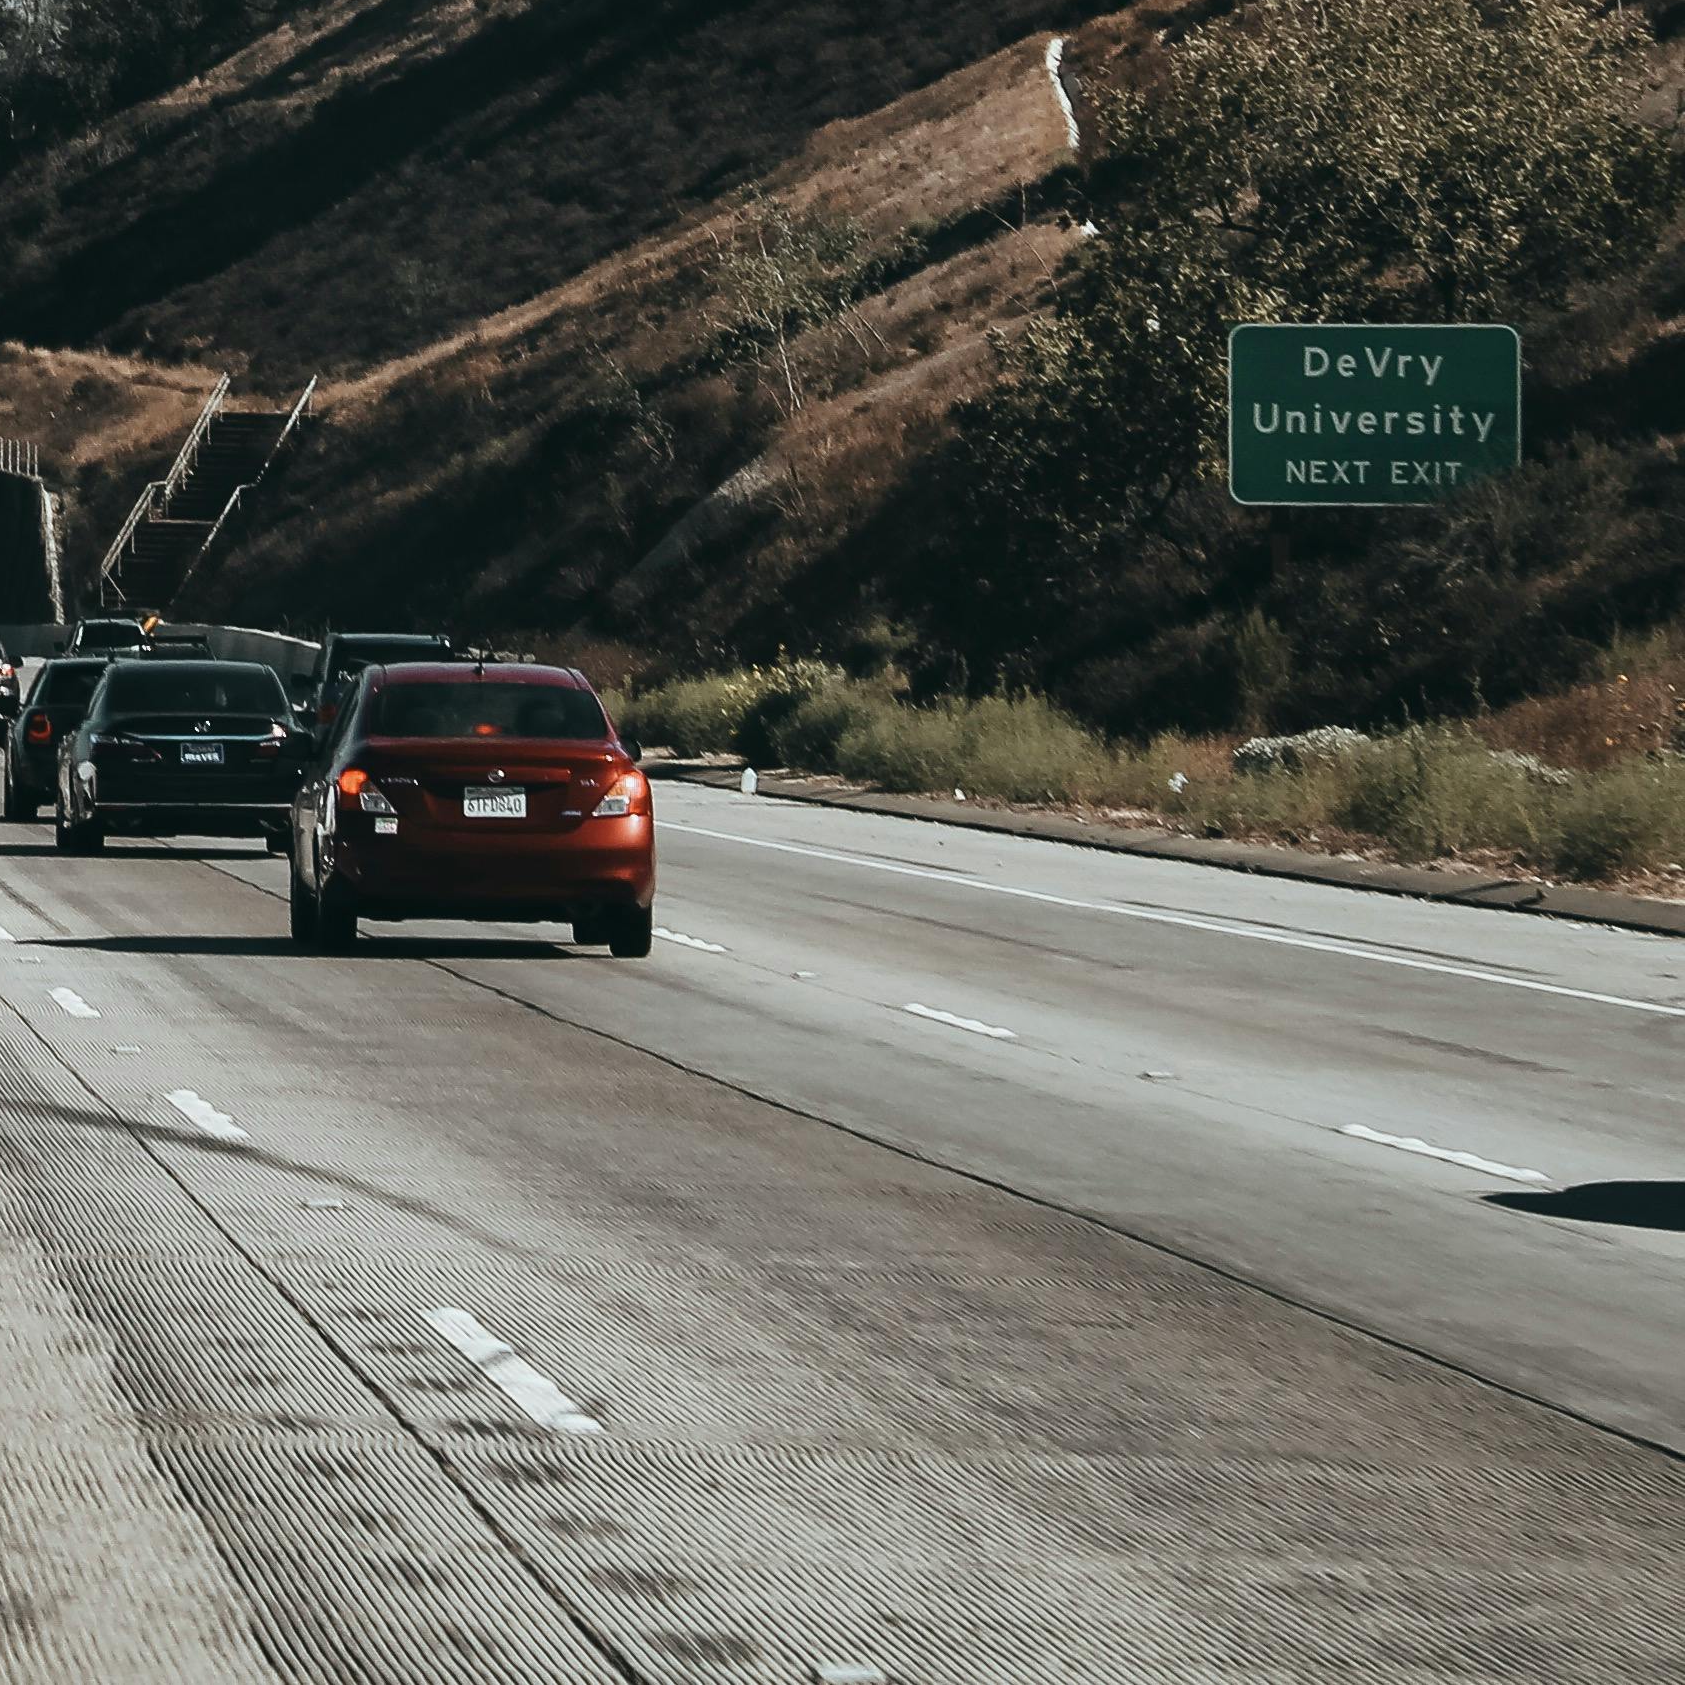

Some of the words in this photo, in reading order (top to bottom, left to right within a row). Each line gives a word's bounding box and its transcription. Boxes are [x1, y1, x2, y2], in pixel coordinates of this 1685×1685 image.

[1303, 346, 1443, 386] DeVry
[1252, 402, 1496, 443] University
[1285, 460, 1370, 485] NEXT
[1390, 460, 1462, 486] EXIT
